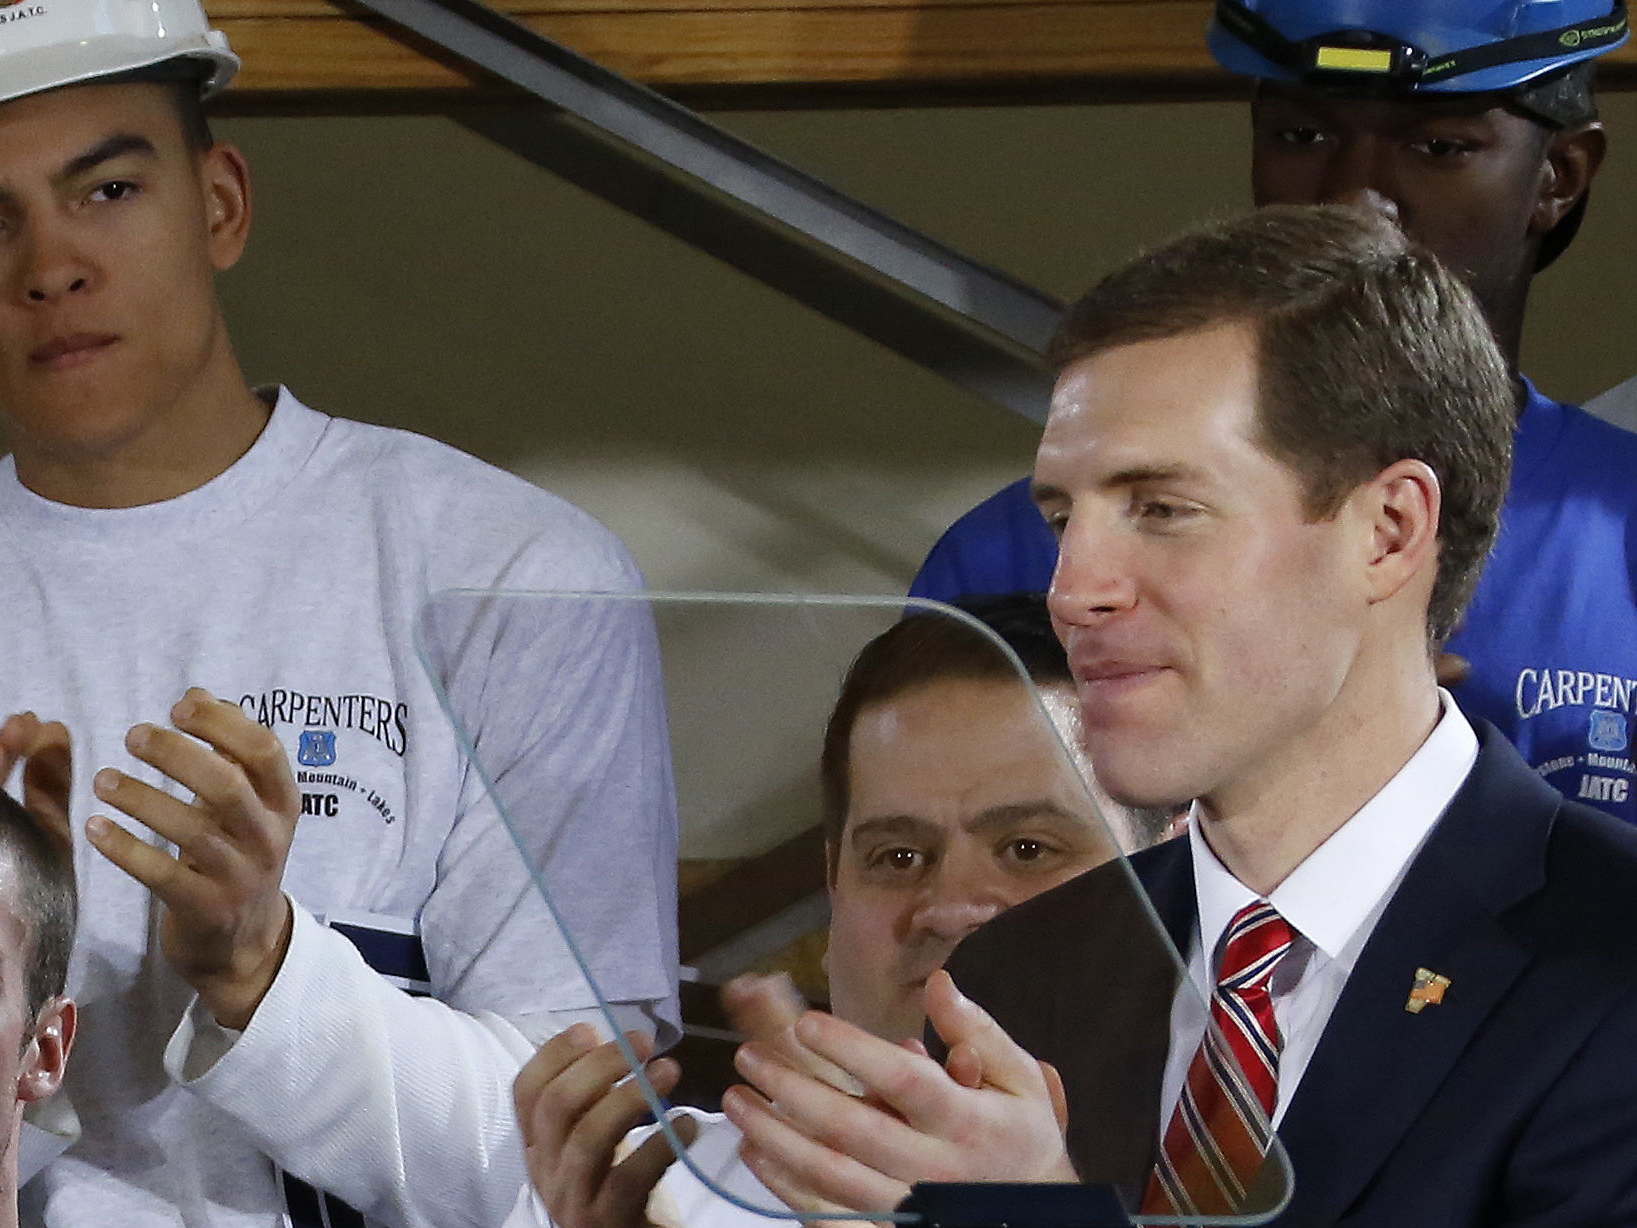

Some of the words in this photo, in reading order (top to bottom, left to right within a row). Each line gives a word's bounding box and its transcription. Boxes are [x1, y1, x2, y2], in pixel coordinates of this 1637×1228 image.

[239, 689, 408, 757] CARPENTERS
[297, 770, 358, 792] Mountain
[367, 790, 396, 826] Lakes
